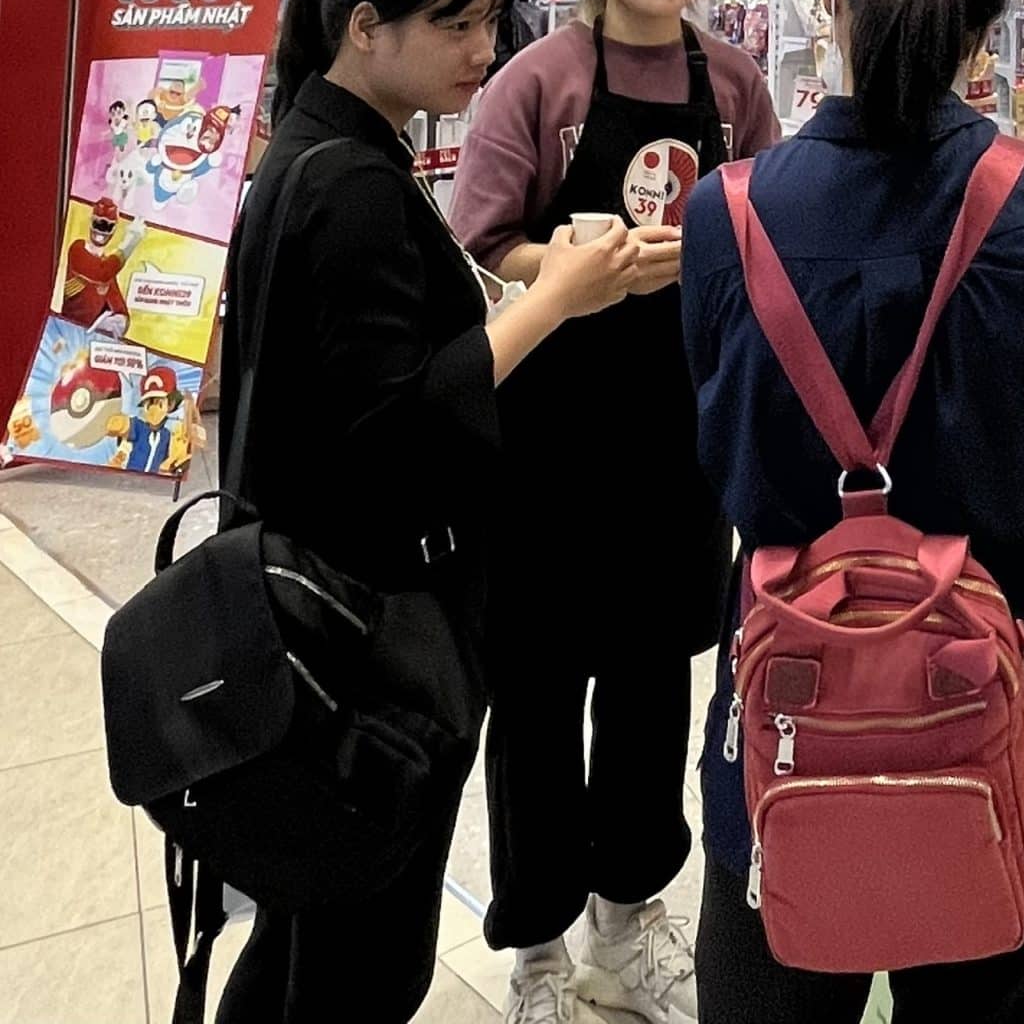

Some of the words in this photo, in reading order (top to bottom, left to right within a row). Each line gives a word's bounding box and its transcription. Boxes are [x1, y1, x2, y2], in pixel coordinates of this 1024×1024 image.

[111, 2, 148, 26] SẢN
[148, 3, 201, 26] PHẨM
[200, 2, 254, 29] NHẬT
[629, 183, 664, 201] KONNI
[634, 198, 658, 217] 39
